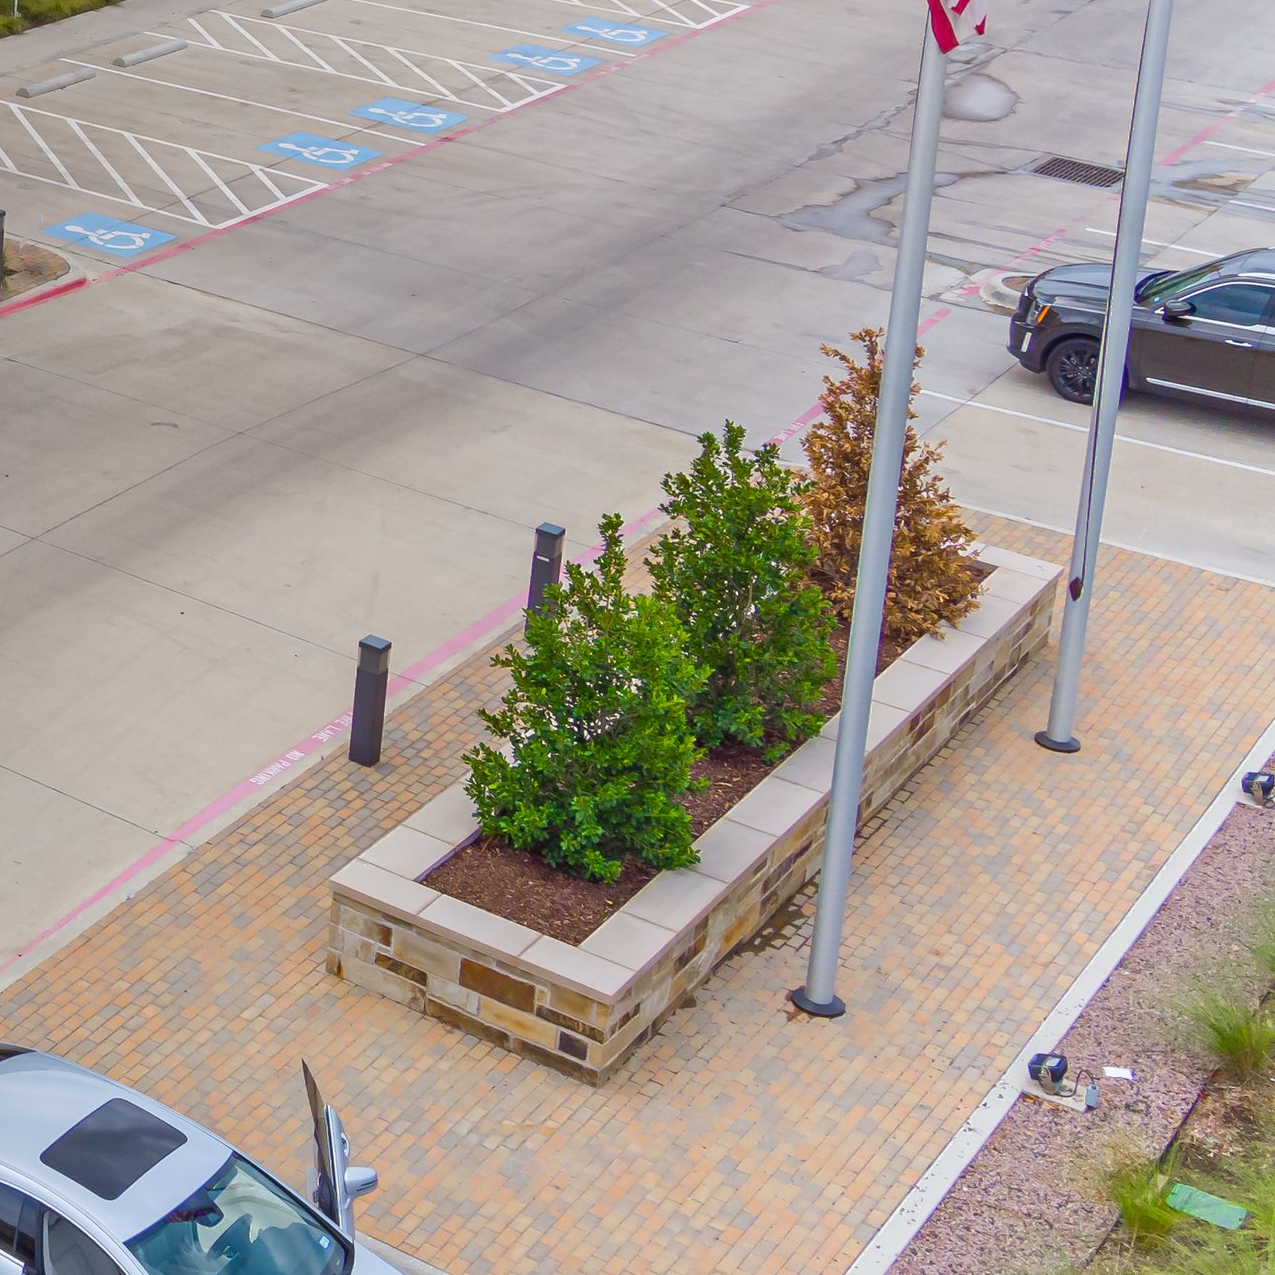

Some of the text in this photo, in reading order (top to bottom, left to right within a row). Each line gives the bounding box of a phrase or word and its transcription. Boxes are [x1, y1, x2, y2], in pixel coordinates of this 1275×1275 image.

[311, 724, 342, 743] LANE
[286, 749, 306, 761] NO
[249, 759, 291, 785] PARKING
